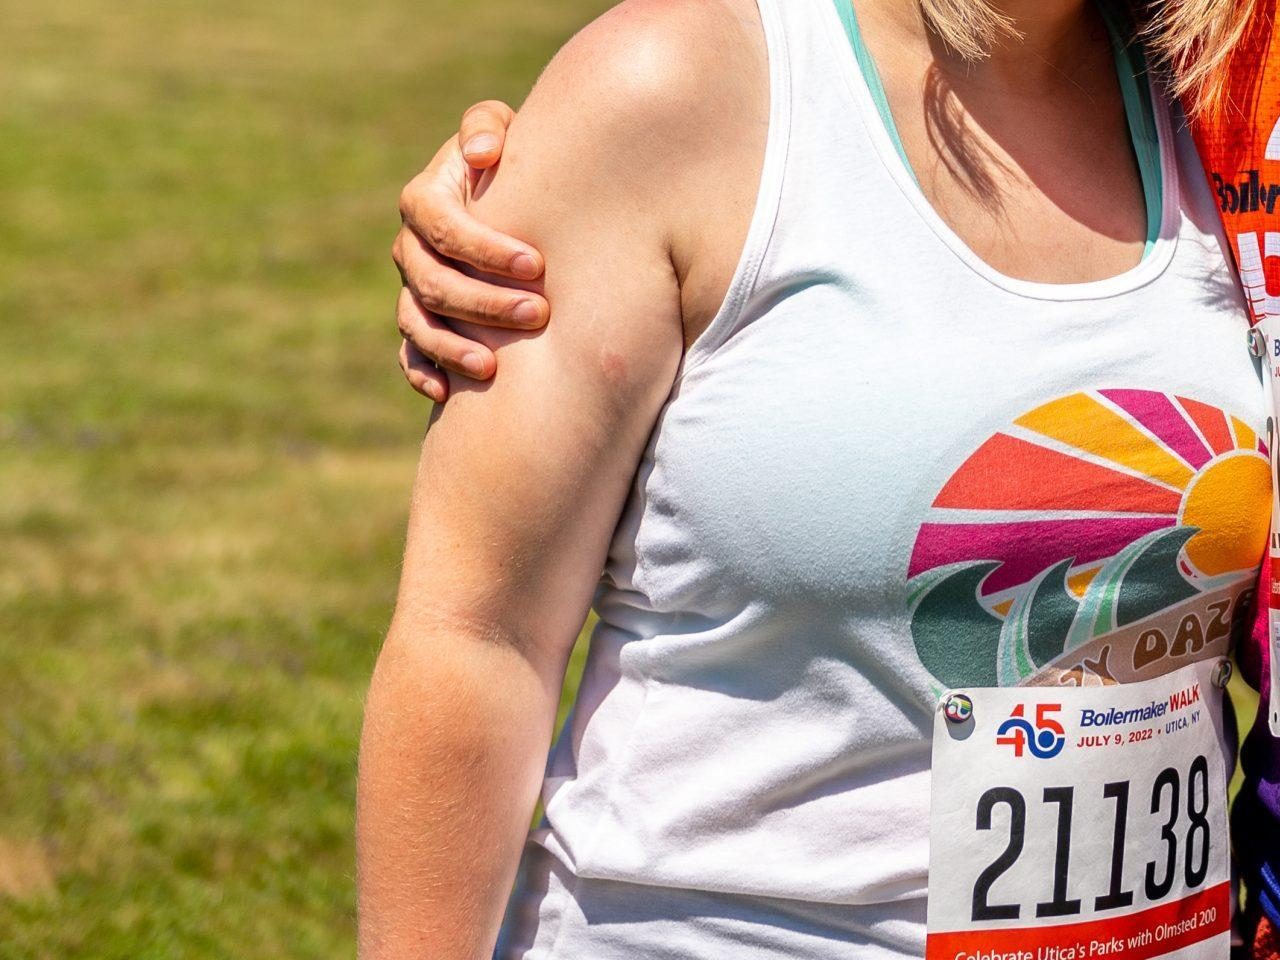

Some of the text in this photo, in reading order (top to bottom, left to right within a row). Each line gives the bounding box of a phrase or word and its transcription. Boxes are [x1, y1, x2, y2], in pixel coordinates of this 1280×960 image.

[1077, 710, 1200, 748] JULY 9, 2022 UTICA, NY
[1080, 683, 1200, 728] Boilermaker WALK
[971, 755, 1210, 922] 21138
[1038, 942, 1086, 960] Utica's
[1089, 937, 1125, 957] Parks
[1127, 928, 1153, 950] with
[1155, 912, 1197, 942] Olmsted
[1199, 906, 1217, 927] 200
